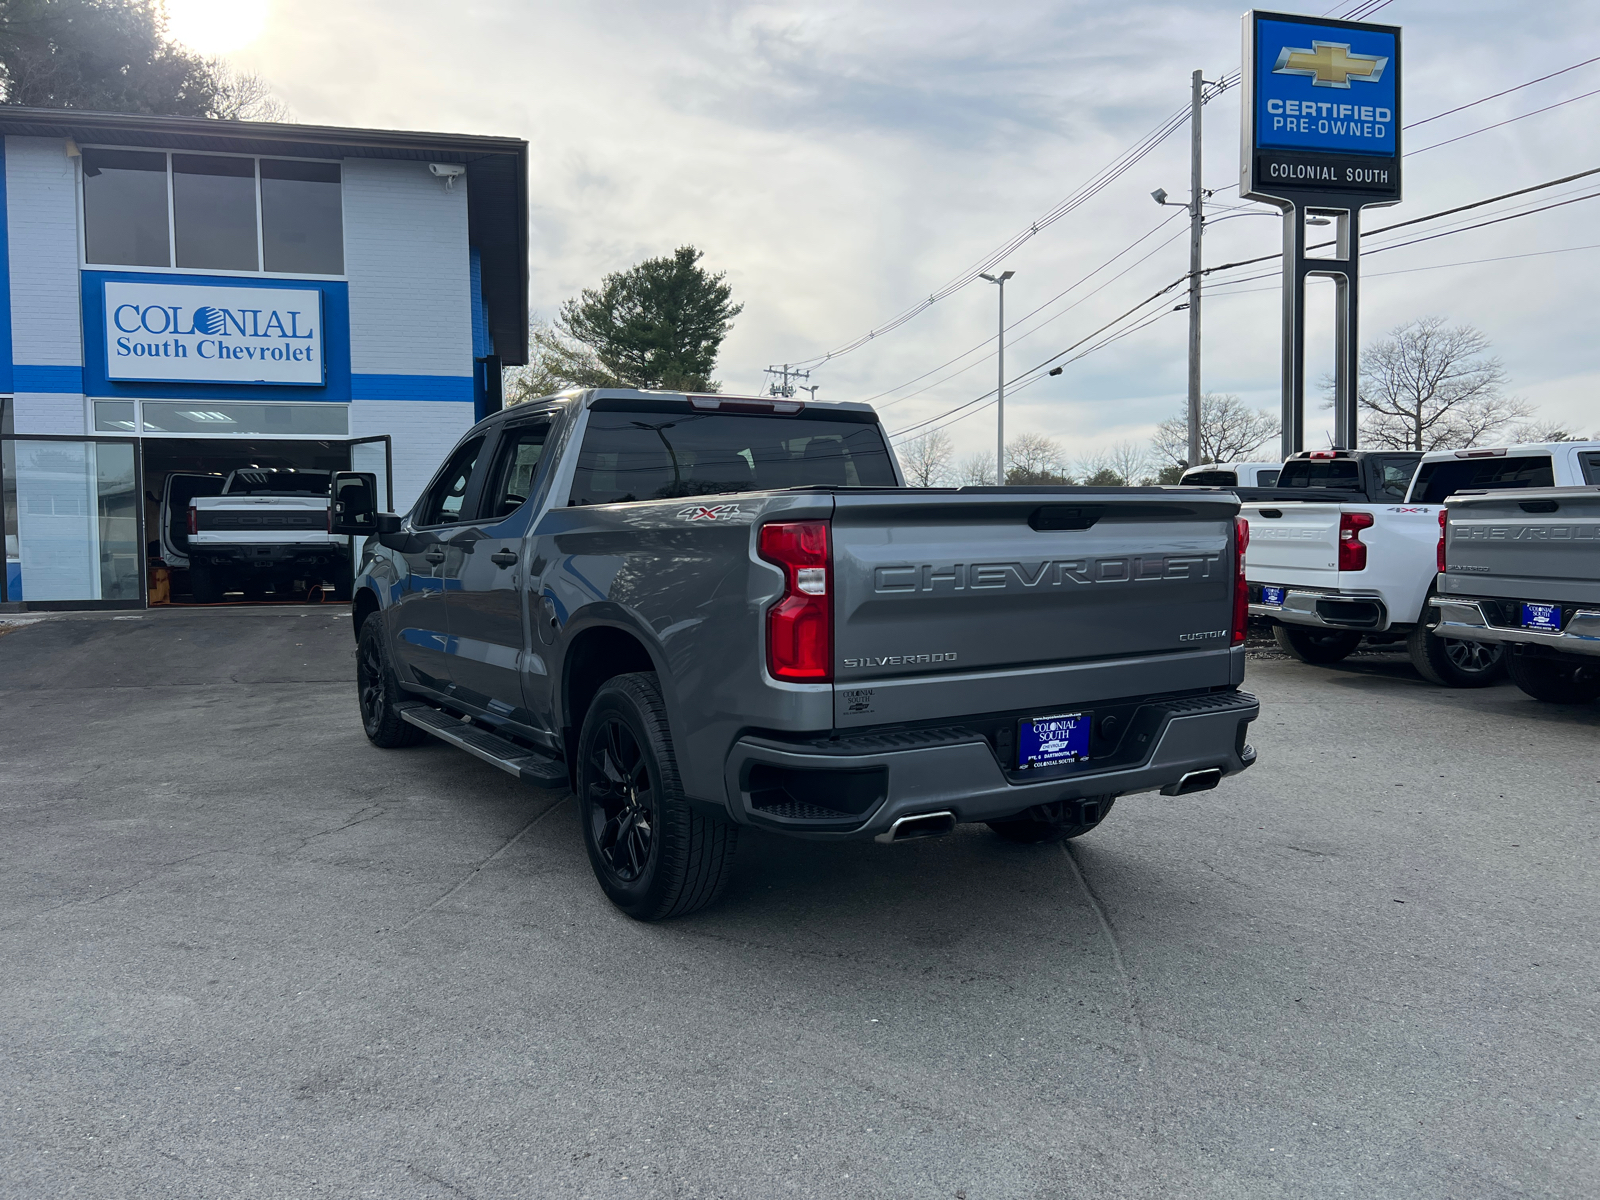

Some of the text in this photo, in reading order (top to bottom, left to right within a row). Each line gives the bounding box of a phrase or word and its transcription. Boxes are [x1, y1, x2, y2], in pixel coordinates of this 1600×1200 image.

[1267, 98, 1391, 122] CERTIFIED
[1273, 117, 1386, 138] PRE-OWNED
[1270, 163, 1388, 183] COLONIAL SOUTH
[113, 304, 314, 339] COLONIAL
[116, 336, 314, 361] South Chevrolet
[212, 516, 313, 525] FORD
[874, 553, 1220, 593] CHEVROLET
[1179, 629, 1228, 641] CUSTOM
[843, 652, 958, 668] SILVERADO
[842, 689, 876, 698] COLONIAL
[847, 696, 870, 704] SOUTH
[1033, 720, 1077, 733] COLONIAL
[1039, 729, 1069, 742] SOUTH
